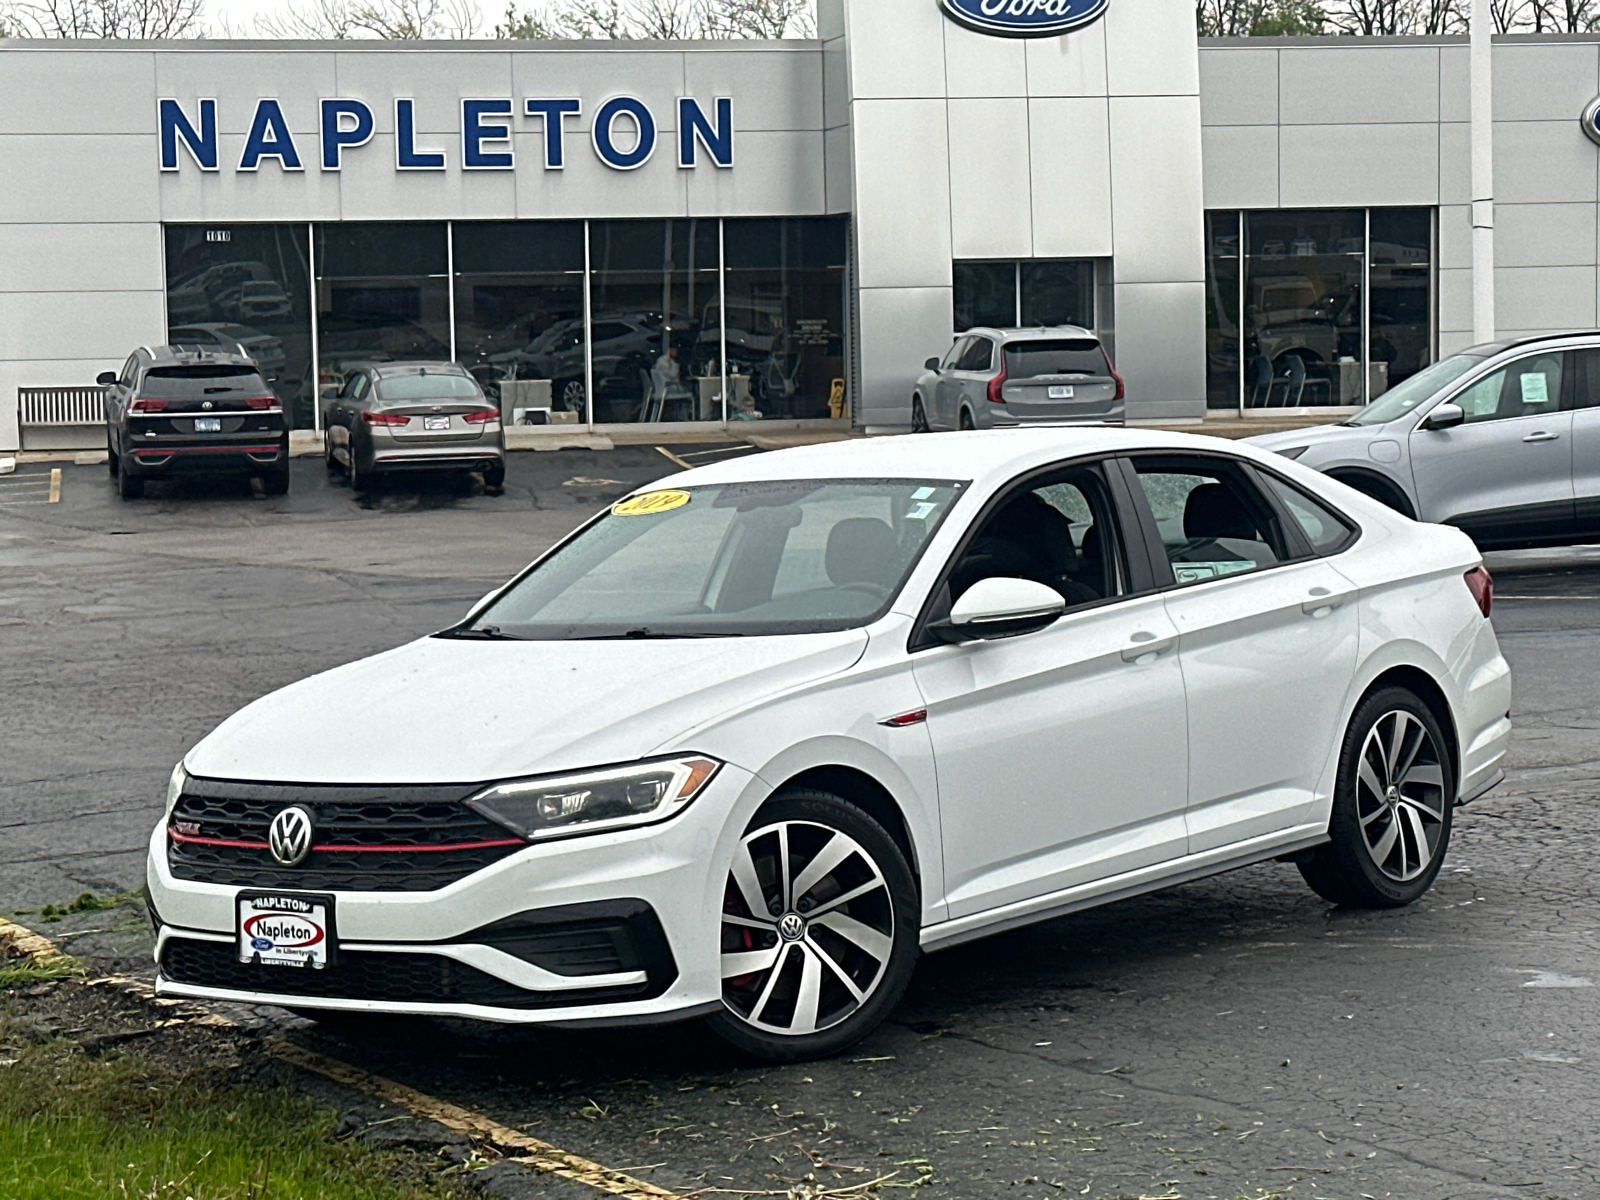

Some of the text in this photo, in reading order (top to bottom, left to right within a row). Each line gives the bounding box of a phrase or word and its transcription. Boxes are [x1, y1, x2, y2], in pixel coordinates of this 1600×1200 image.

[157, 95, 734, 173] NAPLETON
[207, 231, 230, 241] 1010
[256, 898, 306, 911] NAPLETON
[257, 919, 311, 941] Napleton
